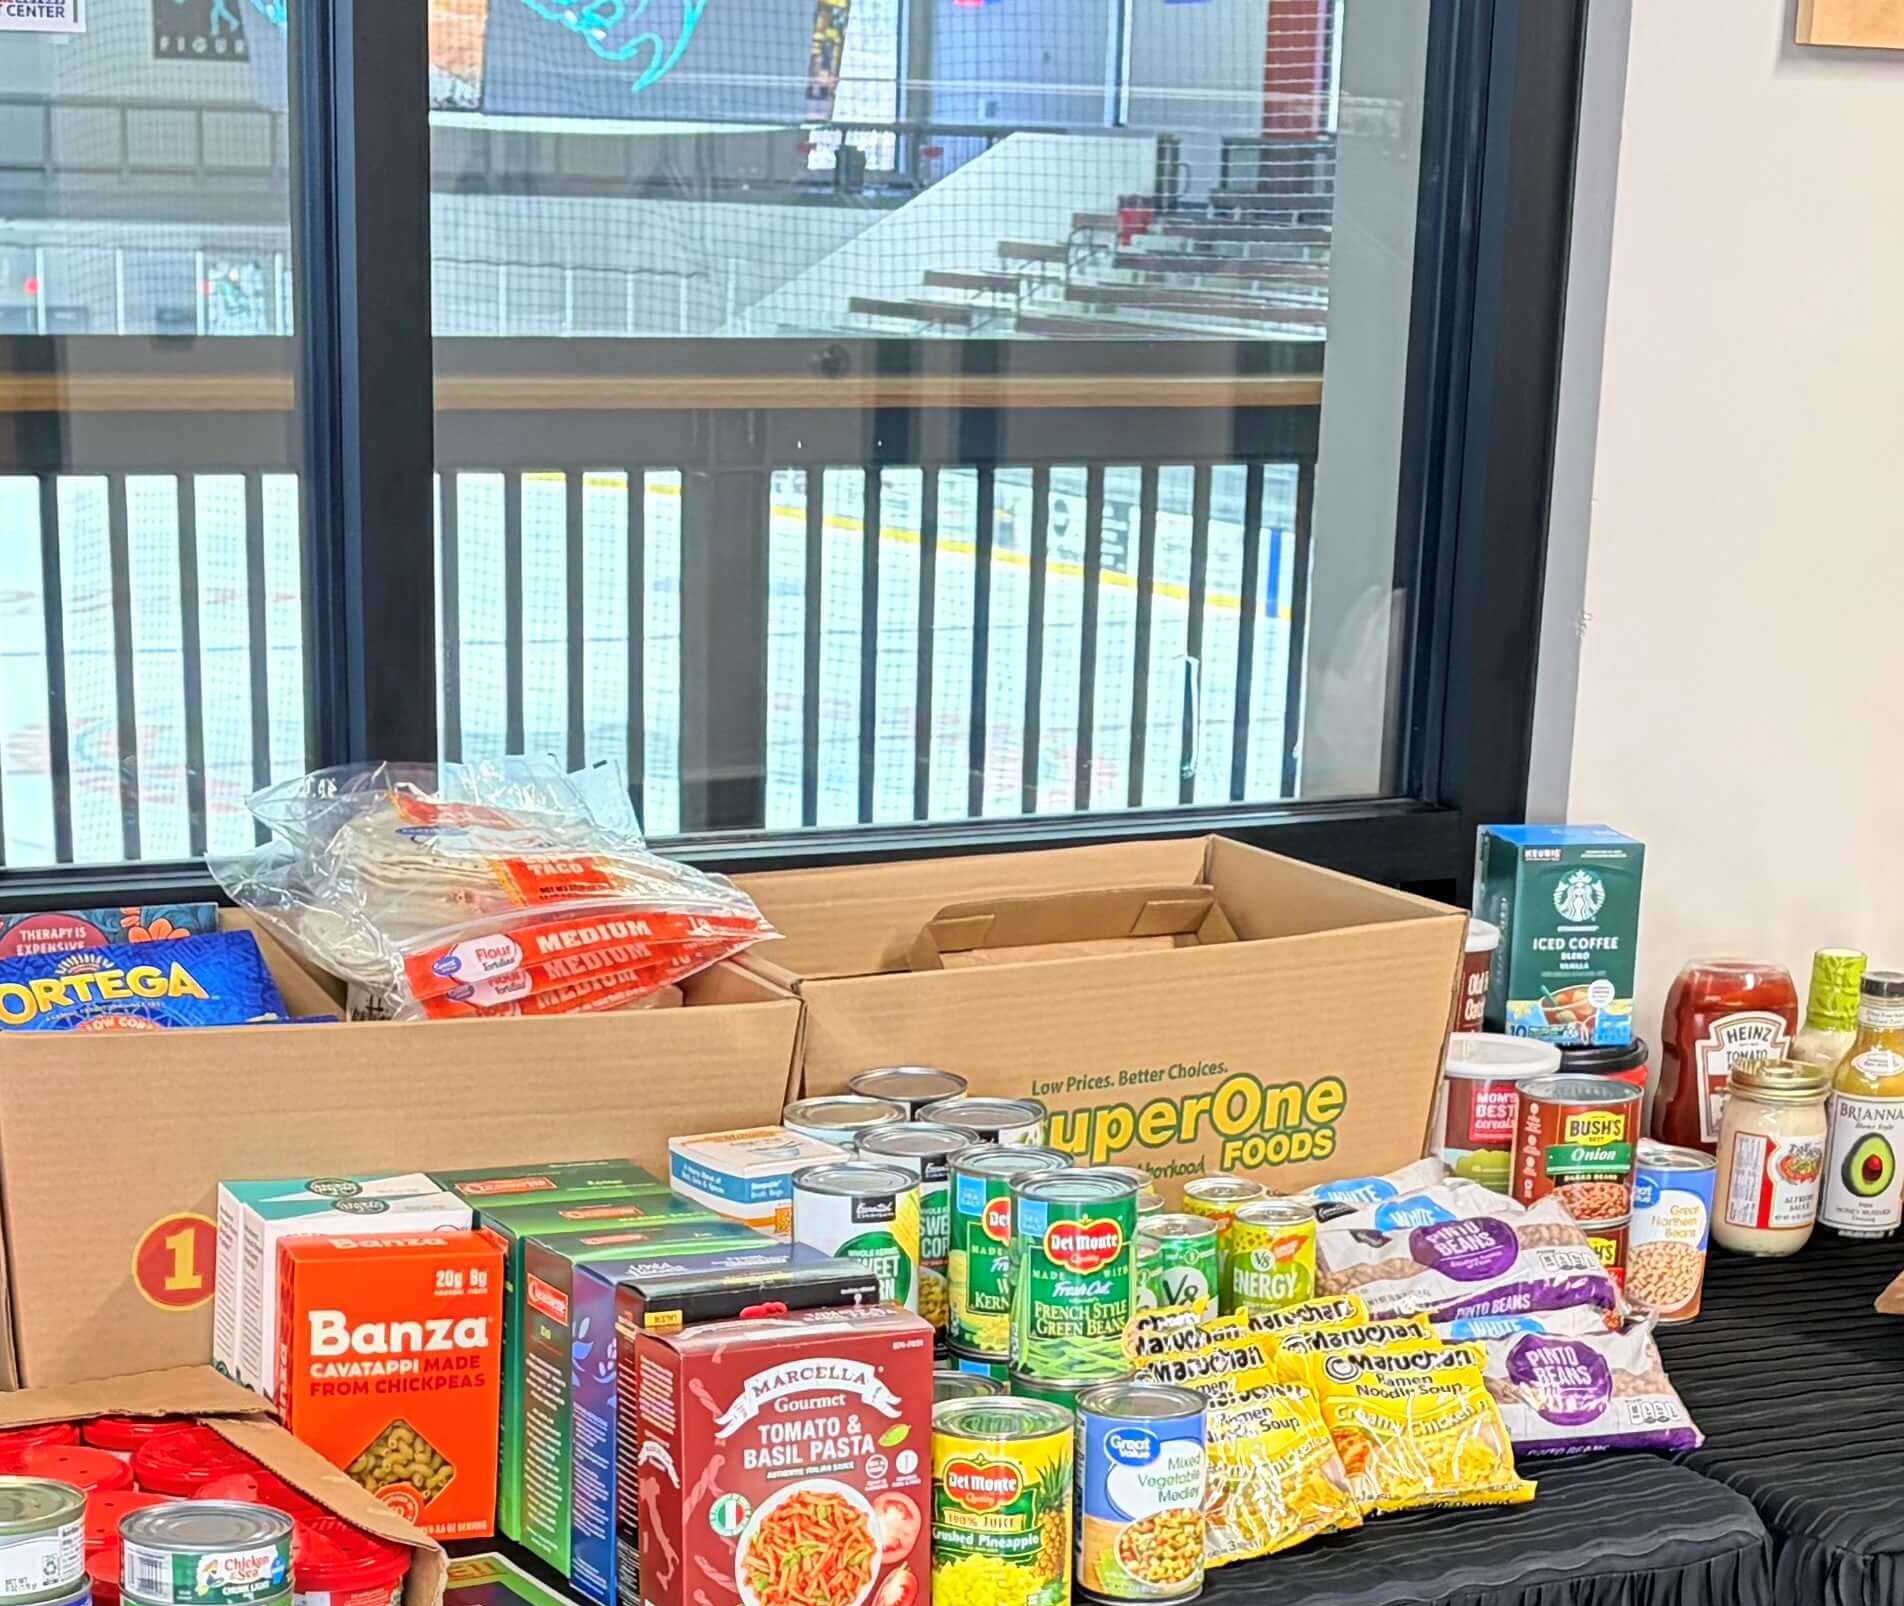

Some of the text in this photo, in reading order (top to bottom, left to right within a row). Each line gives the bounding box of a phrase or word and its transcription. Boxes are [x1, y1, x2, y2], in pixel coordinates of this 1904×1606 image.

[7, 3, 65, 18] CENTER
[528, 863, 584, 876] TACO
[20, 927, 86, 941] THERAPY IS
[535, 920, 652, 954] MEDIUM
[1533, 937, 1619, 950] ICED COFFEE
[1726, 1025, 1773, 1044] HEINZ
[1031, 1061, 1229, 1096] Low Prices. Better Choices.
[1569, 1119, 1622, 1137] BUSH'S
[1221, 1127, 1336, 1172] FOODS
[1571, 1148, 1617, 1161] Onion
[1051, 1235, 1118, 1251] Del Monte
[161, 1227, 202, 1291] 1
[435, 1268, 487, 1289] 20g 8g
[1232, 1272, 1298, 1302] ENERGY
[1034, 1299, 1128, 1321] FRENCH STYLE
[308, 1309, 489, 1356] Banza
[1036, 1319, 1084, 1337] GREEN
[1309, 1321, 1425, 1351] Maruchan
[1526, 1346, 1578, 1366] PINTO
[309, 1355, 481, 1378] CAVATAPPI MADE
[1534, 1366, 1592, 1387] BEANS
[310, 1373, 485, 1397] FROM CHICKPEAS
[751, 1365, 866, 1397] MARCELLA
[1376, 1373, 1433, 1387] Ramen
[1426, 1381, 1463, 1396] Soup
[774, 1393, 846, 1413] Gourmet
[758, 1414, 861, 1444] TOMATO &
[744, 1433, 875, 1470] BASIL PASTA
[1110, 1435, 1151, 1451] Great
[949, 1473, 1017, 1490] Del Monte
[978, 1533, 1039, 1550] Pineapple
